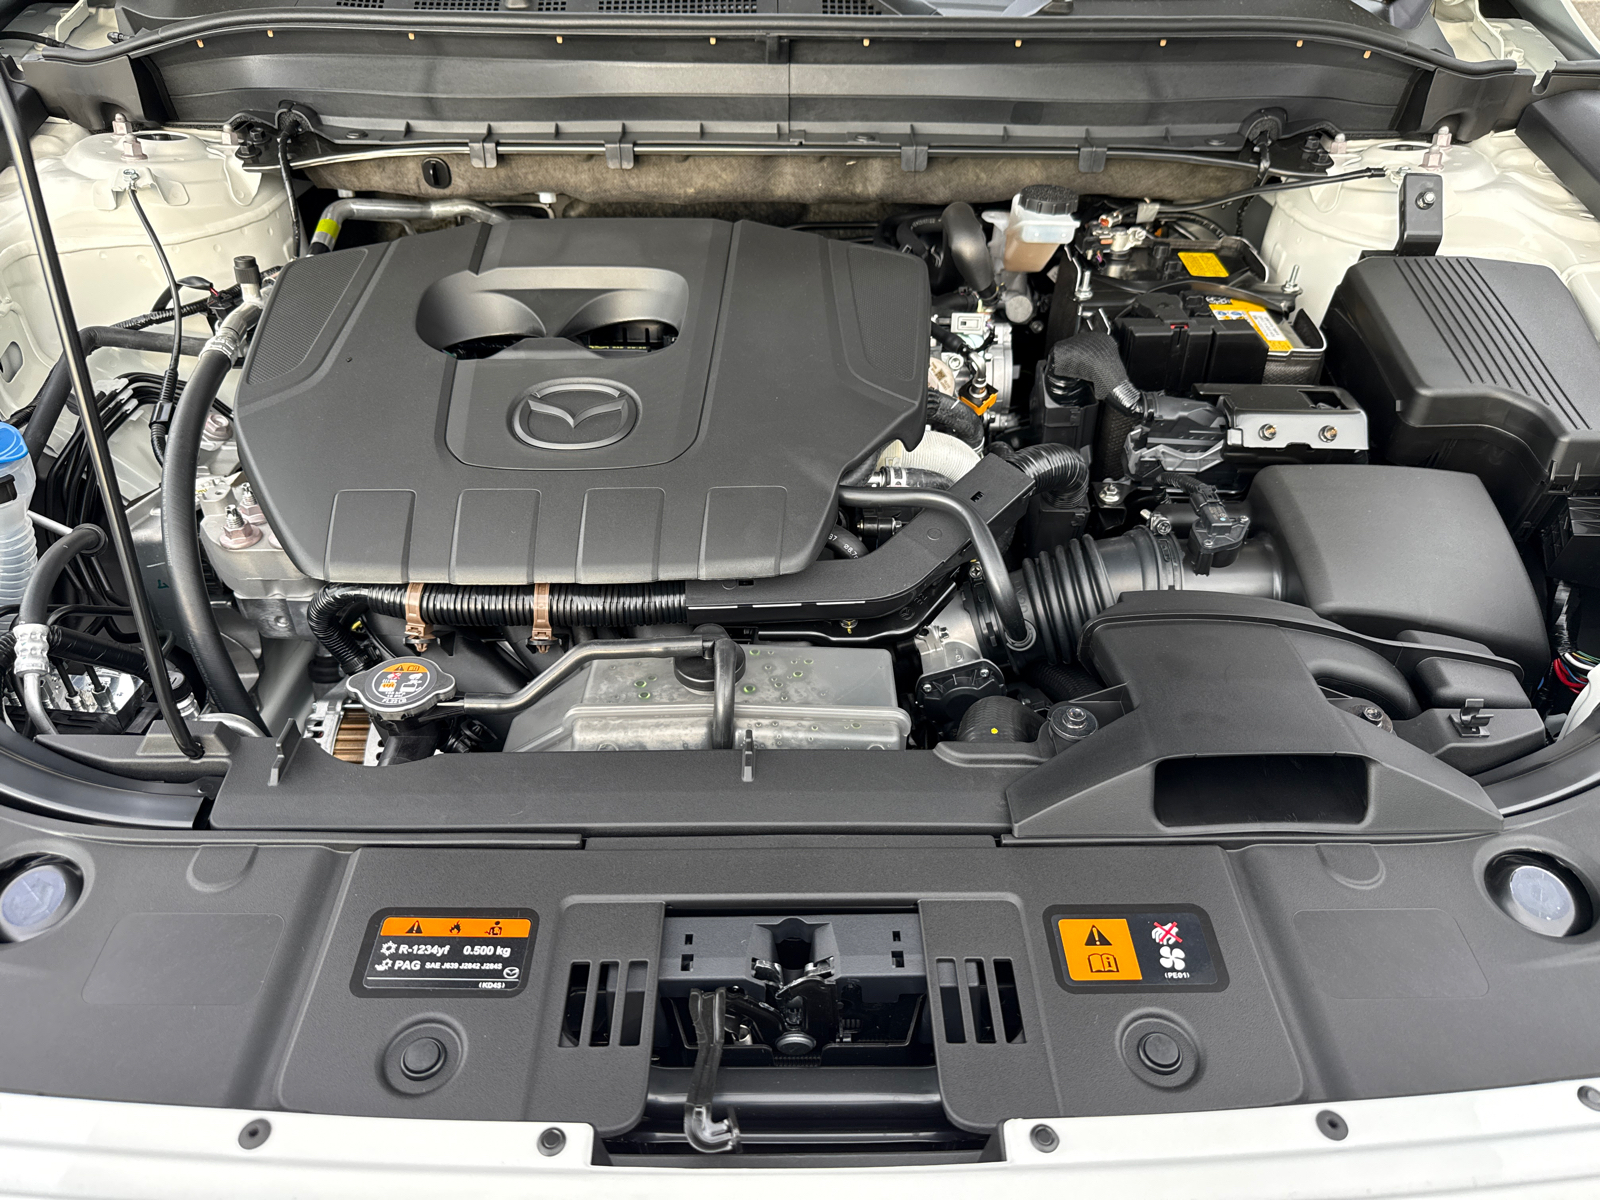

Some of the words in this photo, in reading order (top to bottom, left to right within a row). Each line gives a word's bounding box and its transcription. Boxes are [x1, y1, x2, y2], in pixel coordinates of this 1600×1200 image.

[399, 945, 450, 957] R-1234yf
[463, 945, 494, 955] 0.500
[496, 945, 511, 957] kg
[394, 960, 421, 970] PAG
